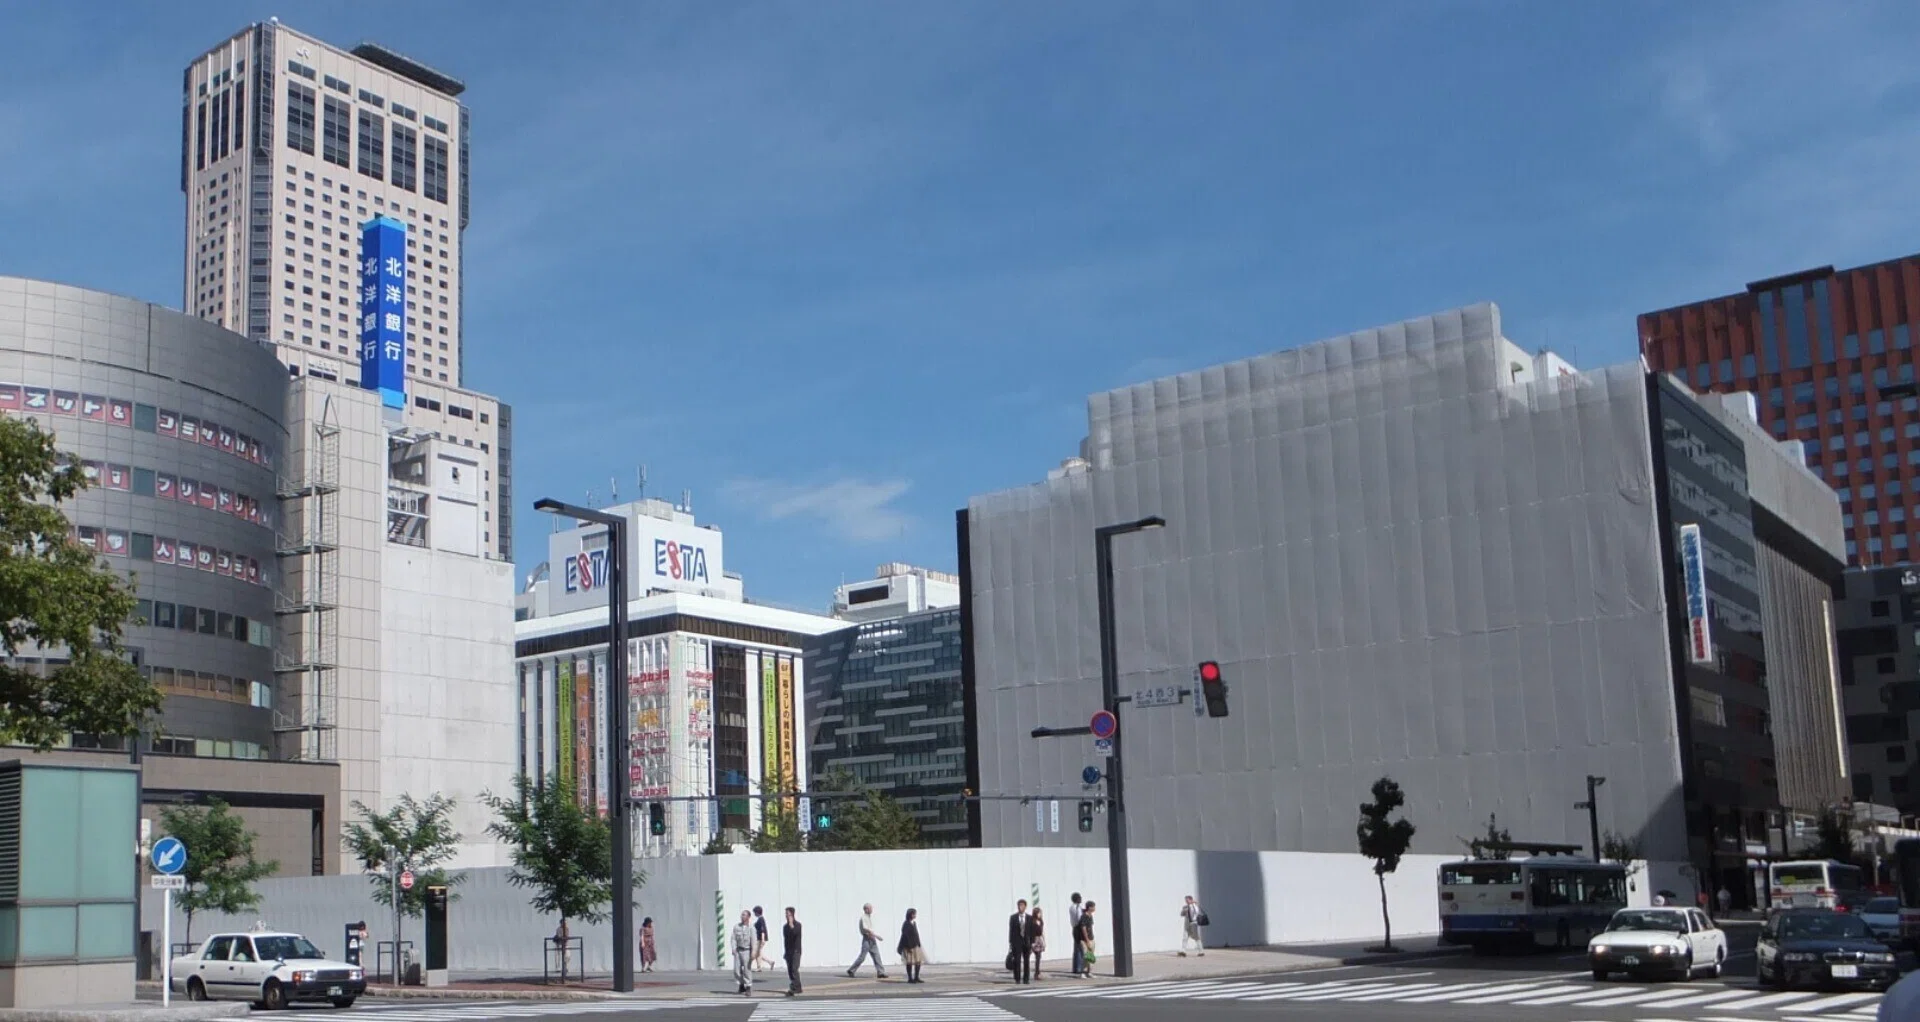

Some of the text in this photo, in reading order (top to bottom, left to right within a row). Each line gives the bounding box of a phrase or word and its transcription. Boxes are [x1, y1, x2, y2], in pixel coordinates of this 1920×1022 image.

[363, 257, 378, 361] 北洋銀行
[384, 256, 402, 361] 北洋銀行
[655, 538, 708, 584] ESTA
